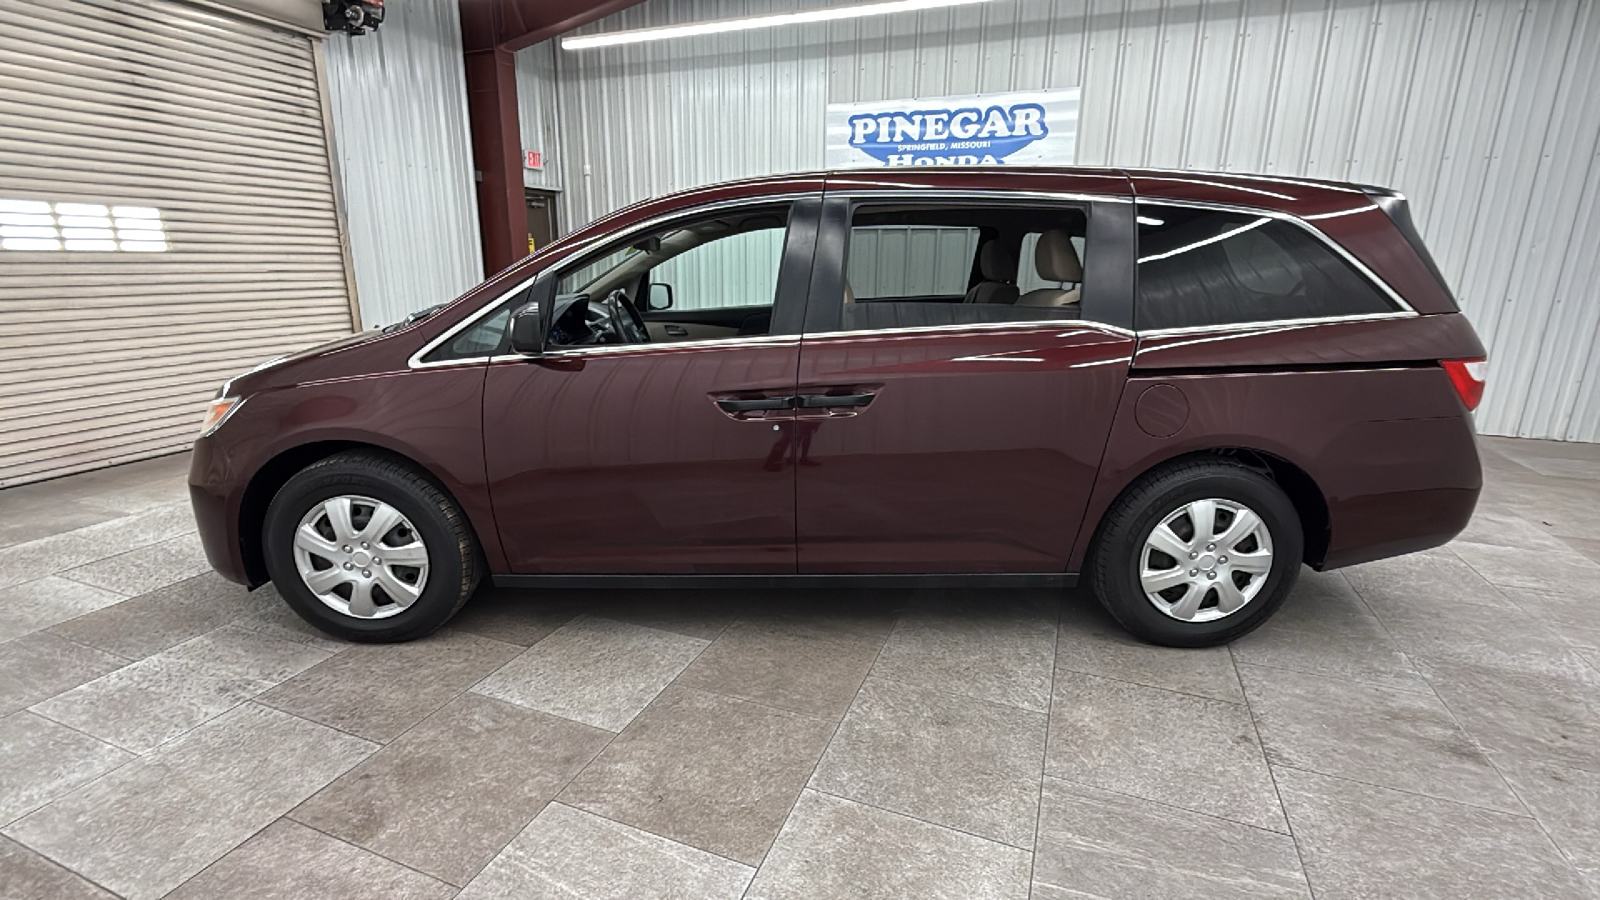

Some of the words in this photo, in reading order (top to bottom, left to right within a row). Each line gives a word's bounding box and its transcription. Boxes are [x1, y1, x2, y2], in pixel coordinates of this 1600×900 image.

[852, 108, 1043, 143] PINEGAR
[897, 143, 948, 152] SPRINGFIELD,
[950, 141, 991, 150] MISSOURI
[527, 150, 541, 167] EXIT
[887, 154, 998, 166] HONDA
